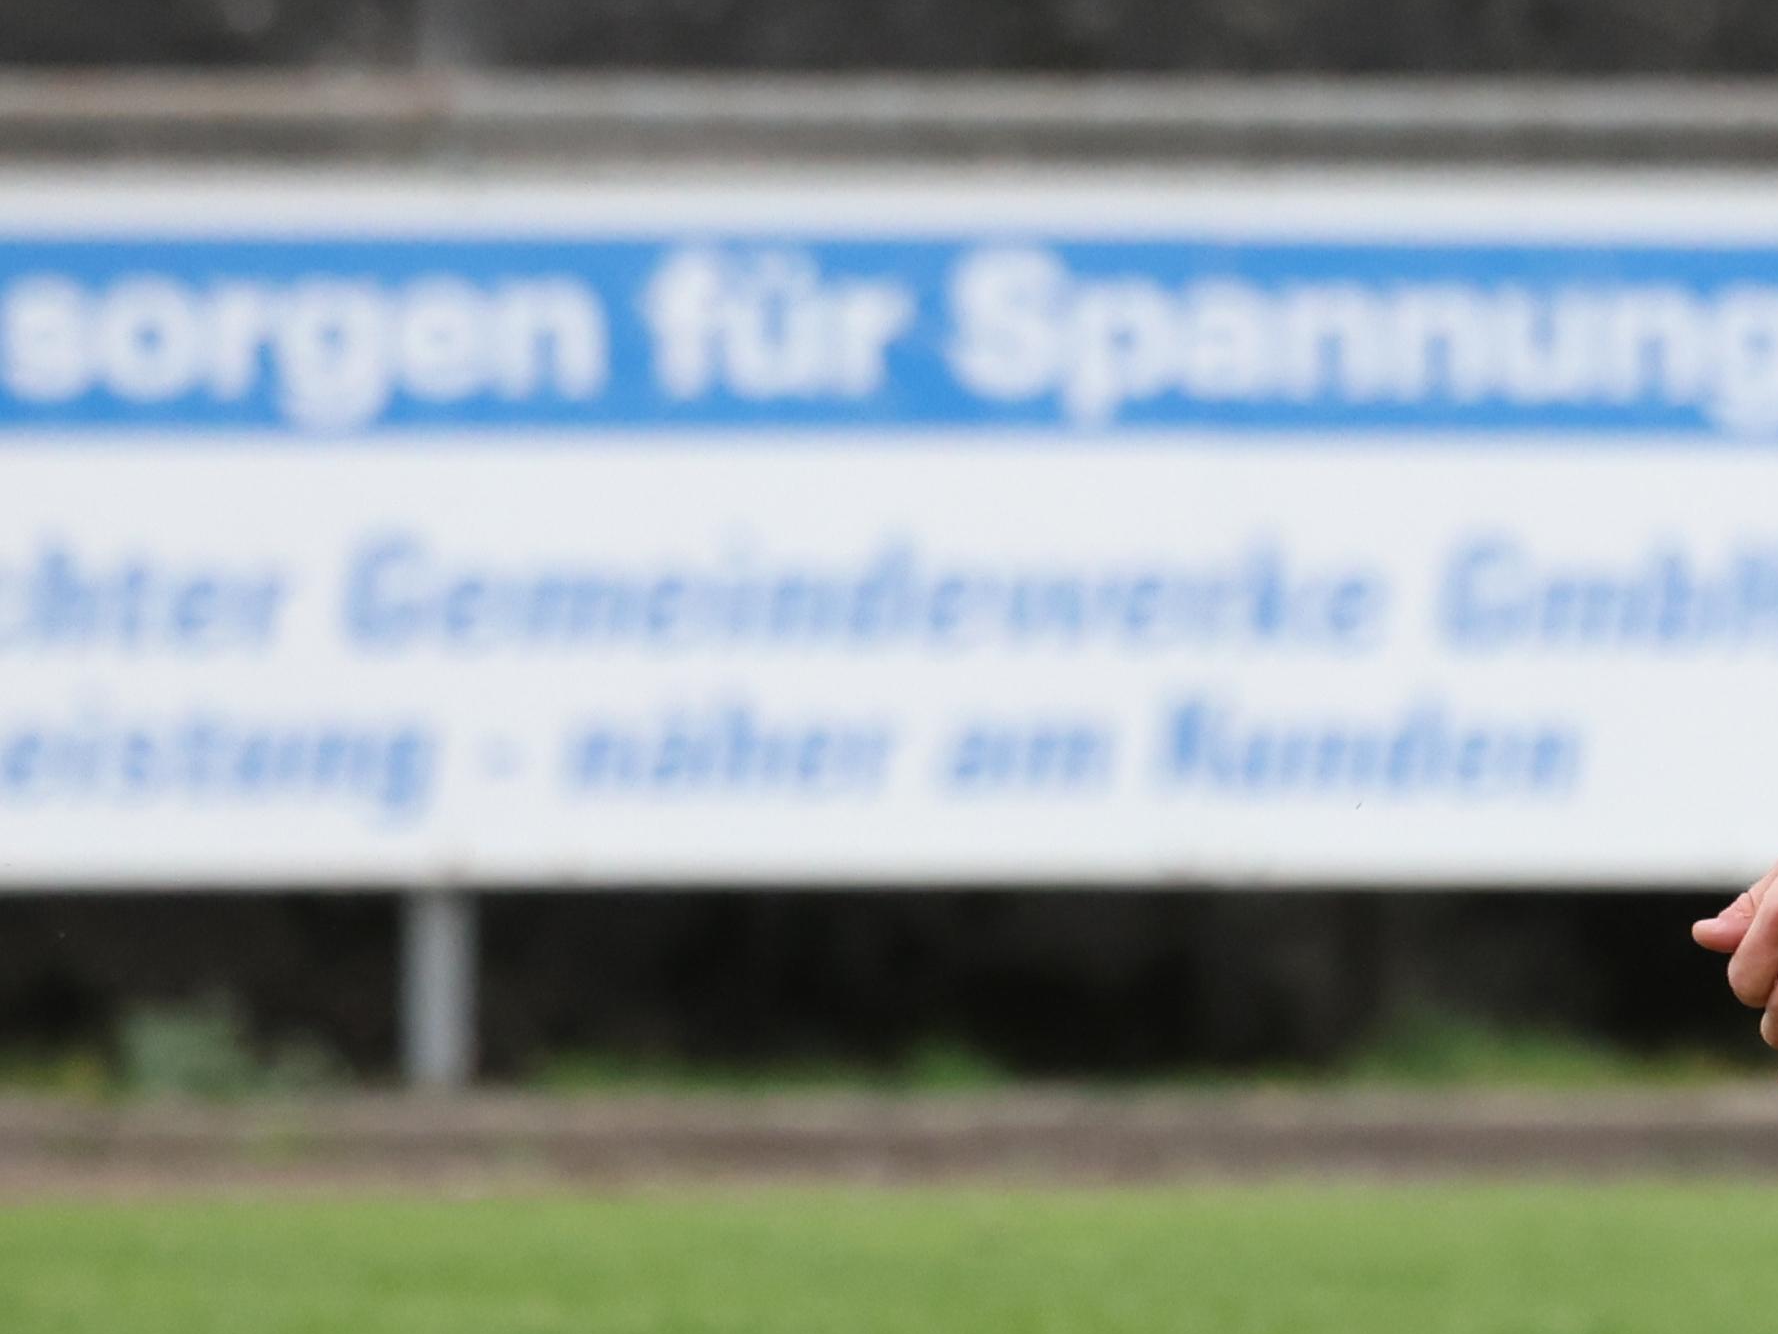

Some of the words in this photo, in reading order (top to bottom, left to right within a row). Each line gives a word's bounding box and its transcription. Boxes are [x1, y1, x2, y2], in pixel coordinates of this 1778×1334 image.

[0, 274, 608, 432] sorgen
[640, 242, 922, 405] für
[340, 527, 1387, 655] Gemeindewerke
[938, 717, 1112, 802] am
[1157, 695, 1582, 802] Kunden
